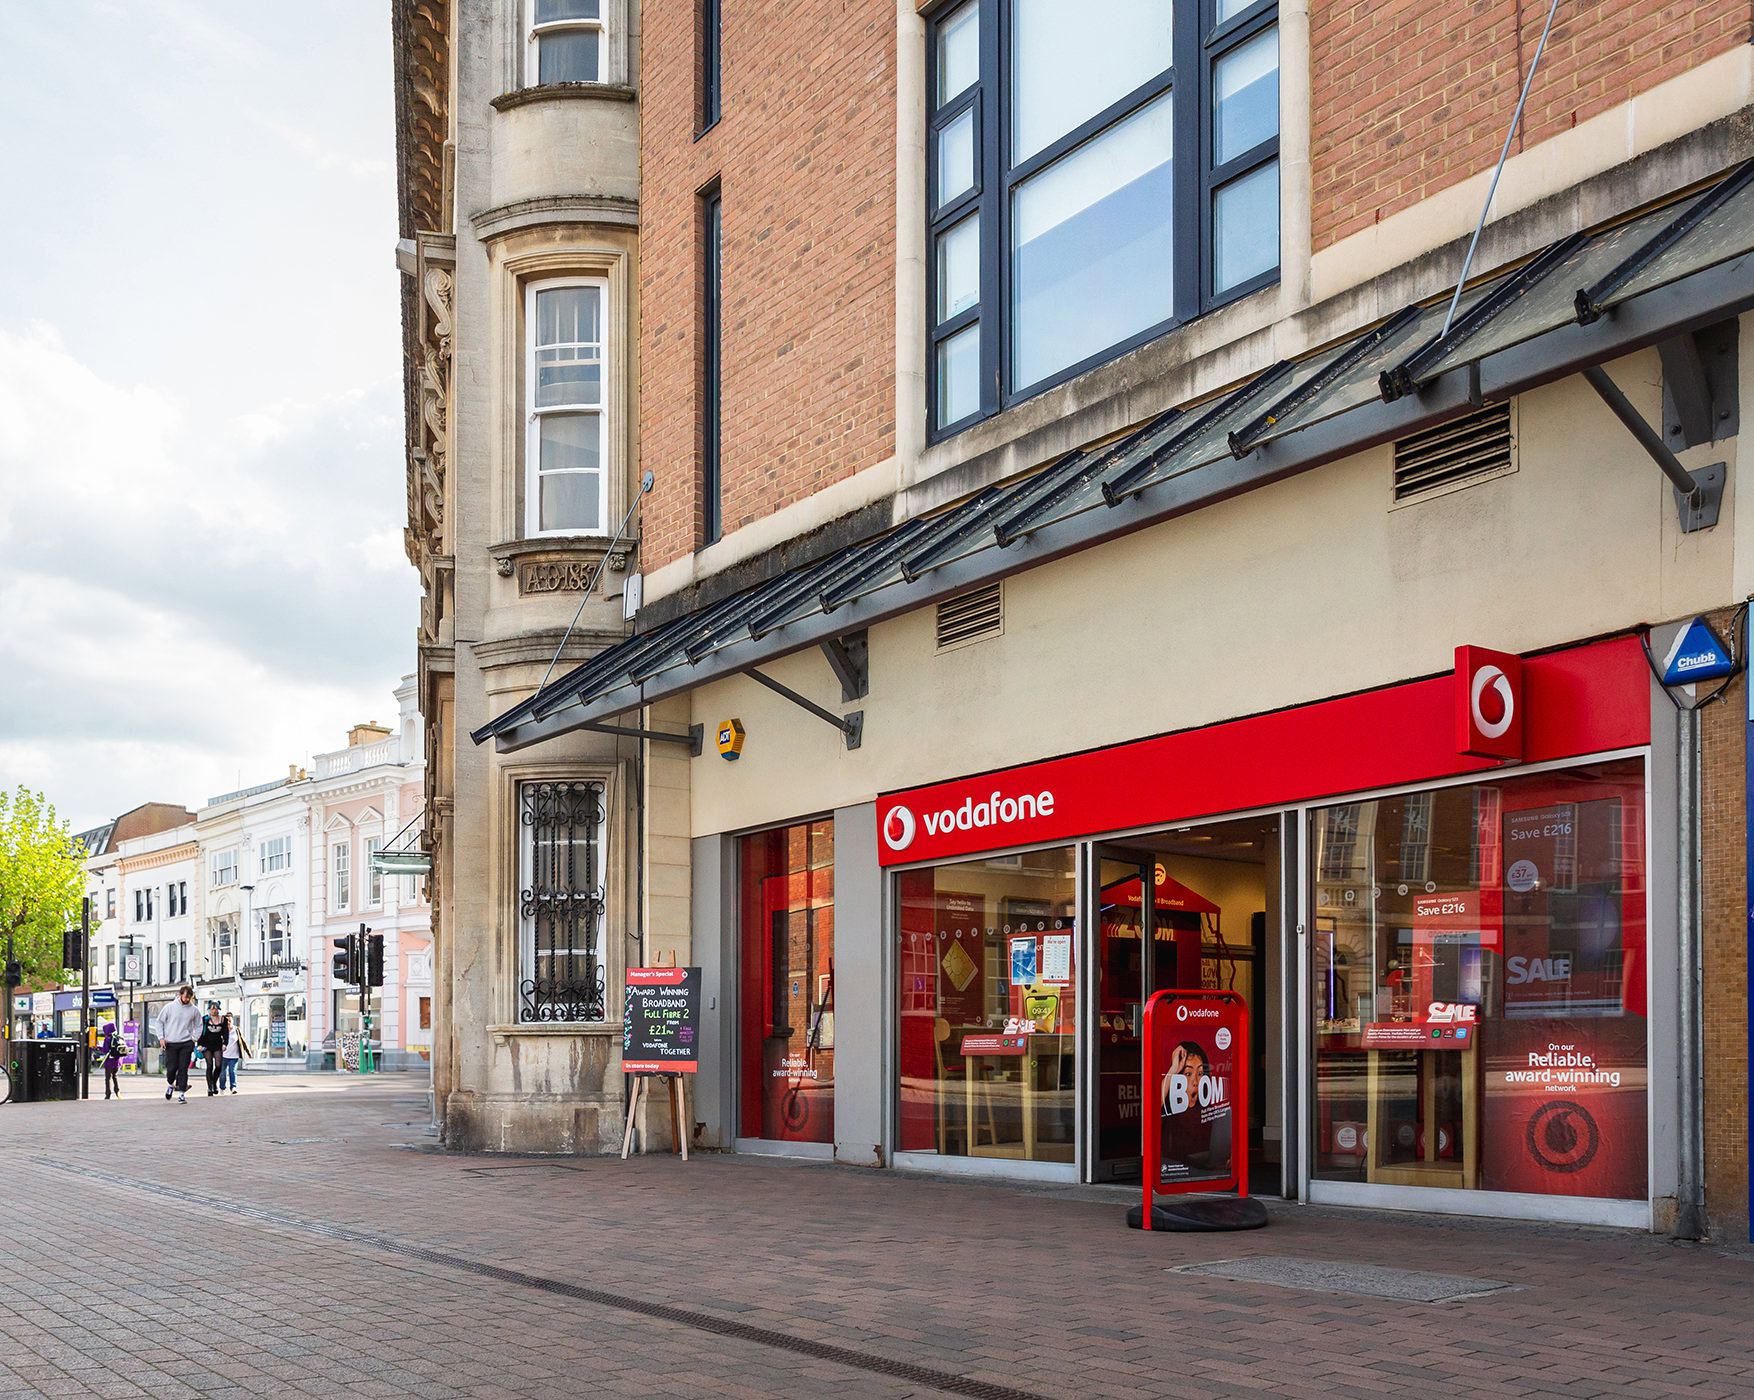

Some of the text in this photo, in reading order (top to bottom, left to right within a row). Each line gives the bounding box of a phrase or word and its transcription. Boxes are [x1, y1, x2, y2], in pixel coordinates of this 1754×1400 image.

[1678, 652, 1716, 667] Chubb
[719, 730, 731, 744] ADT
[923, 791, 1054, 836] vodafone
[1511, 815, 1538, 823] SAMSUNG
[1511, 823, 1572, 840] Save £216
[1161, 897, 1184, 906] Broadband
[1417, 903, 1465, 916] Save £216
[1506, 956, 1570, 984] SALE
[632, 986, 689, 996] AWARD WINNING
[642, 998, 686, 1008] BROADBAND
[644, 1008, 689, 1018] FULL FIBRE 2
[1188, 1010, 1219, 1018] vodafone
[1427, 1002, 1476, 1022] SALE
[782, 1058, 808, 1068] Reliable,
[1528, 1052, 1596, 1068] Reliable,
[772, 1068, 818, 1078] award-winning
[1505, 1068, 1620, 1087] award-winning
